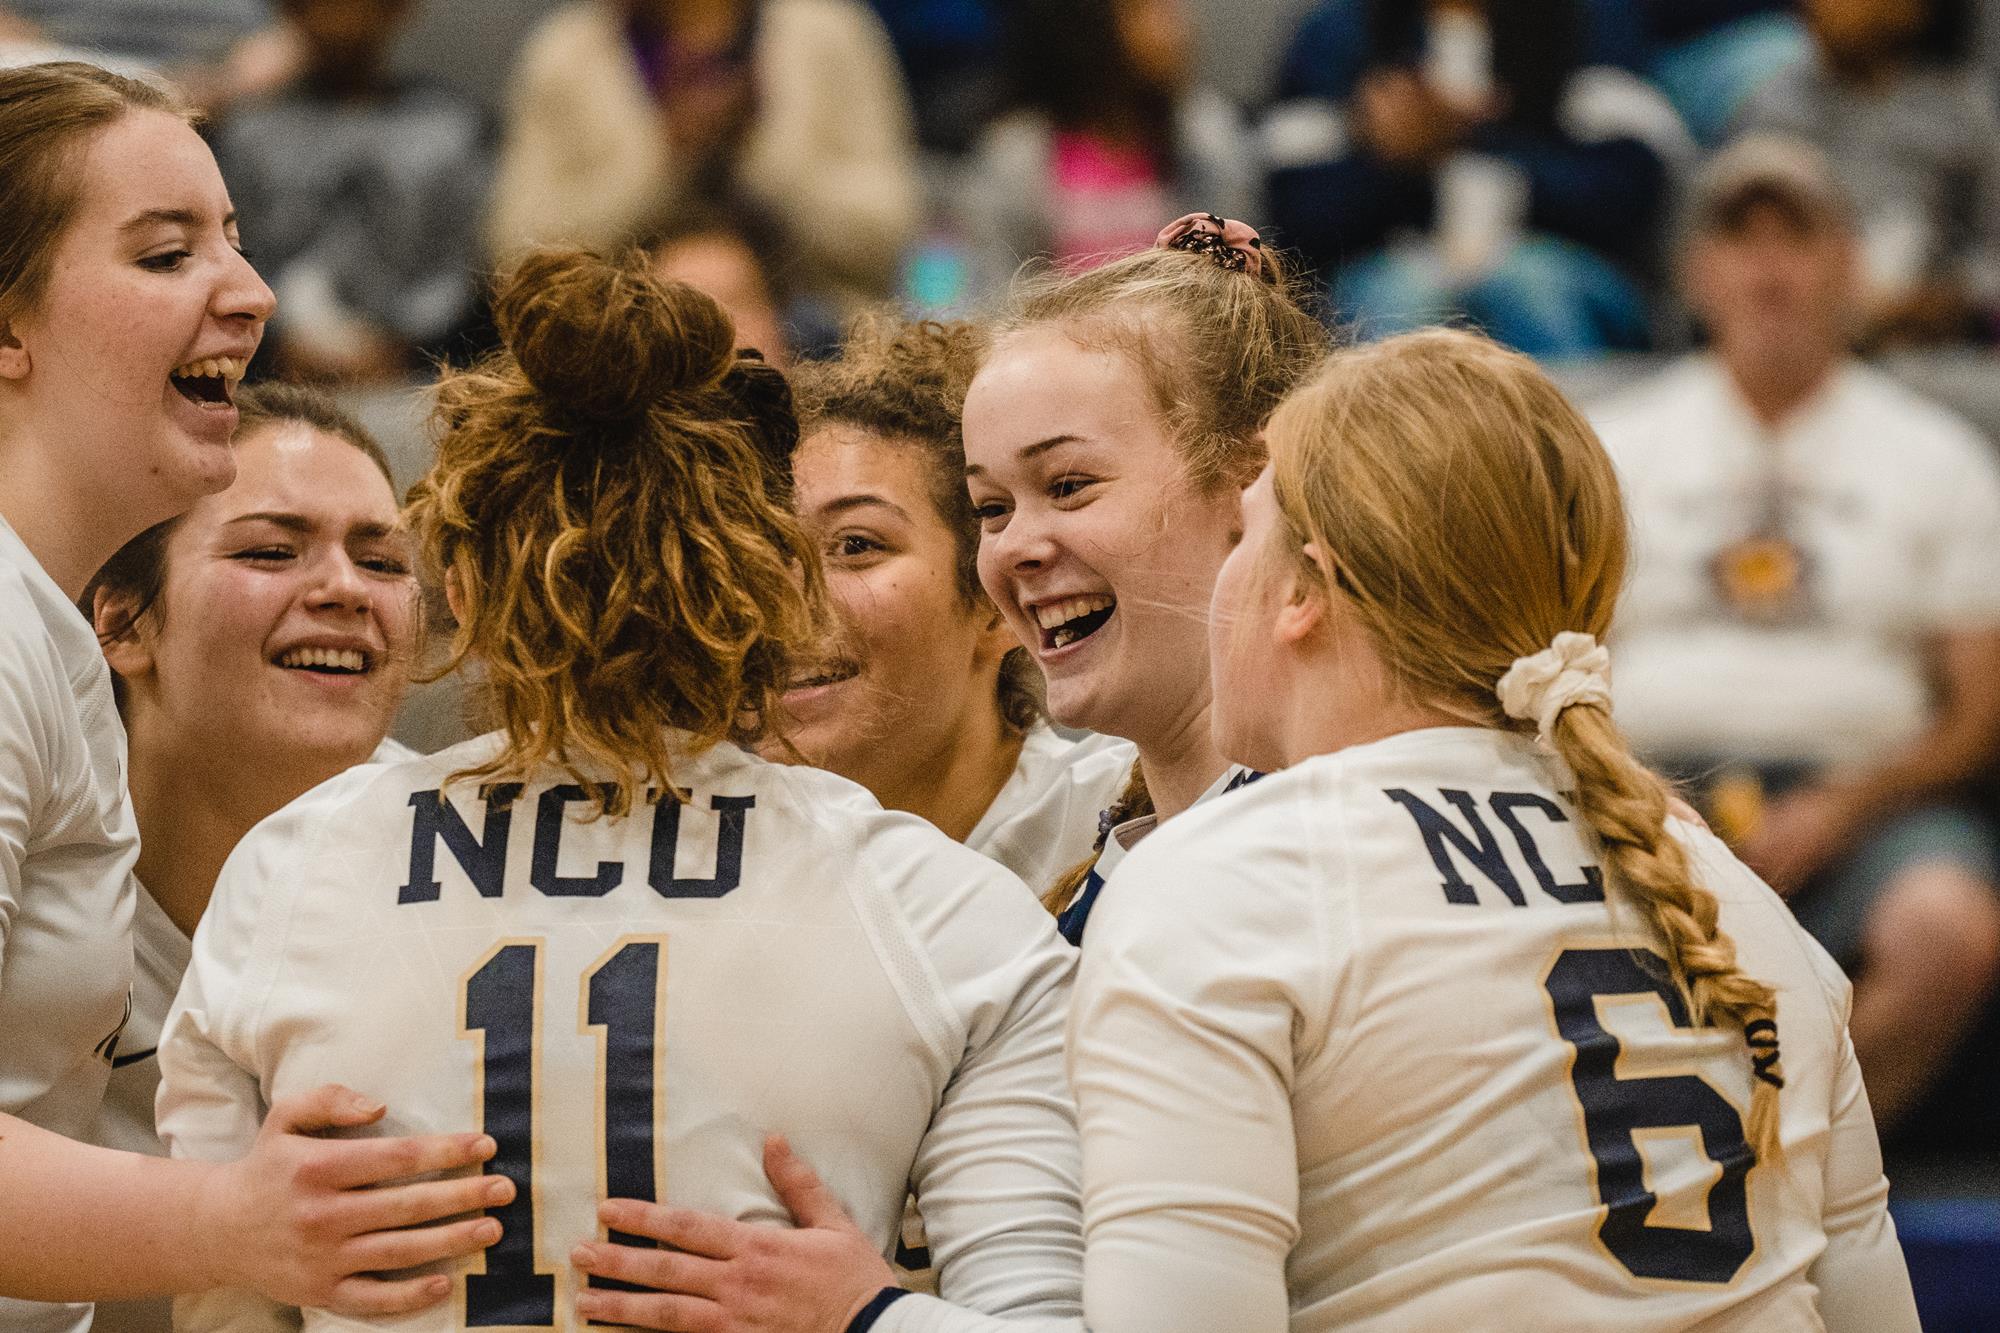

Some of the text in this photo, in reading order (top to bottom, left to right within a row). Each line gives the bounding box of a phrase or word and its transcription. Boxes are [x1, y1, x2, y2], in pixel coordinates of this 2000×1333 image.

[397, 782, 756, 905] NCU
[1382, 786, 1606, 907] NC
[457, 934, 669, 1333] 11
[1541, 945, 1760, 1286] 6
